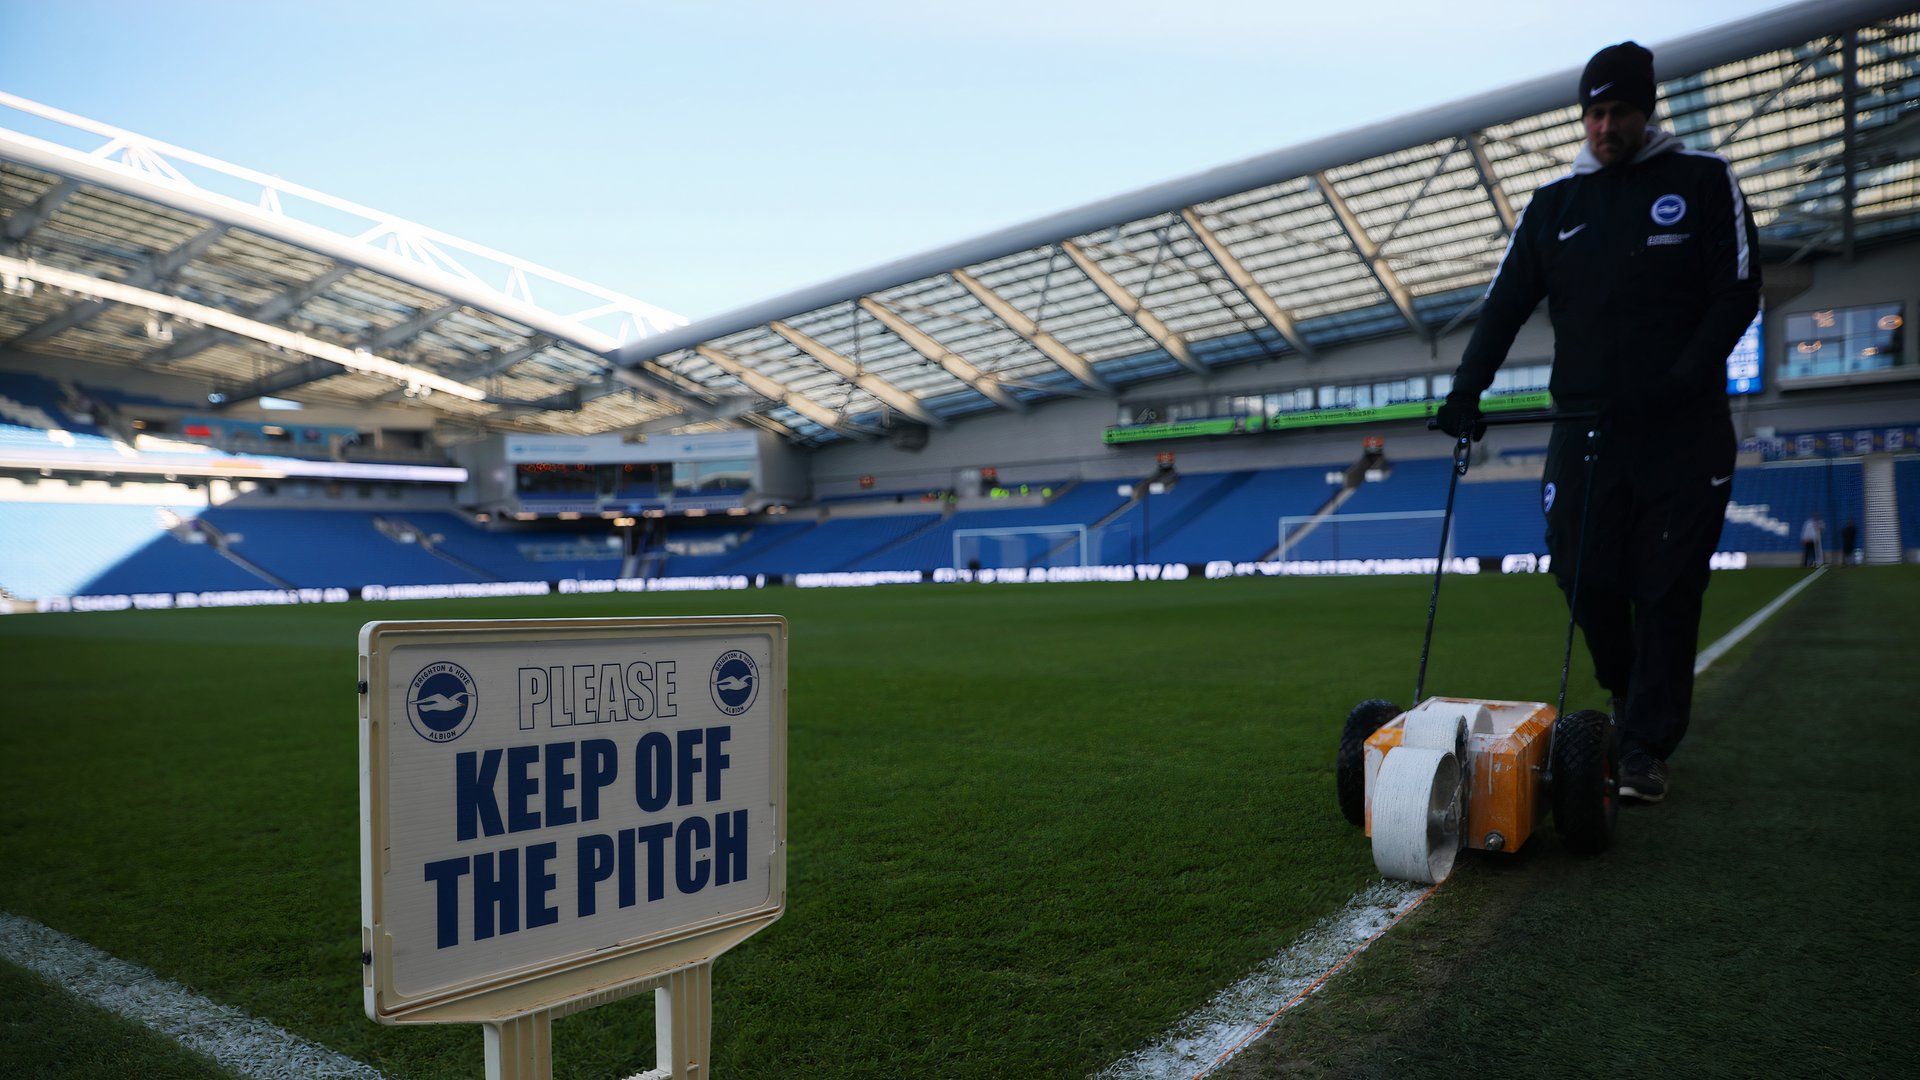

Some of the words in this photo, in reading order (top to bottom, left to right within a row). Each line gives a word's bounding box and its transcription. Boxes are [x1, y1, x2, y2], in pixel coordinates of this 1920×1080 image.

[414, 665, 446, 688] BRIGHTON
[455, 669, 471, 686] HOVE
[715, 653, 738, 671] BRIGHTON
[518, 661, 678, 730] PLEASE
[429, 731, 456, 740] ALBION
[456, 738, 618, 841] KEEP
[635, 726, 731, 812] OFF
[424, 842, 558, 950] THE
[577, 809, 748, 918] PITCH
